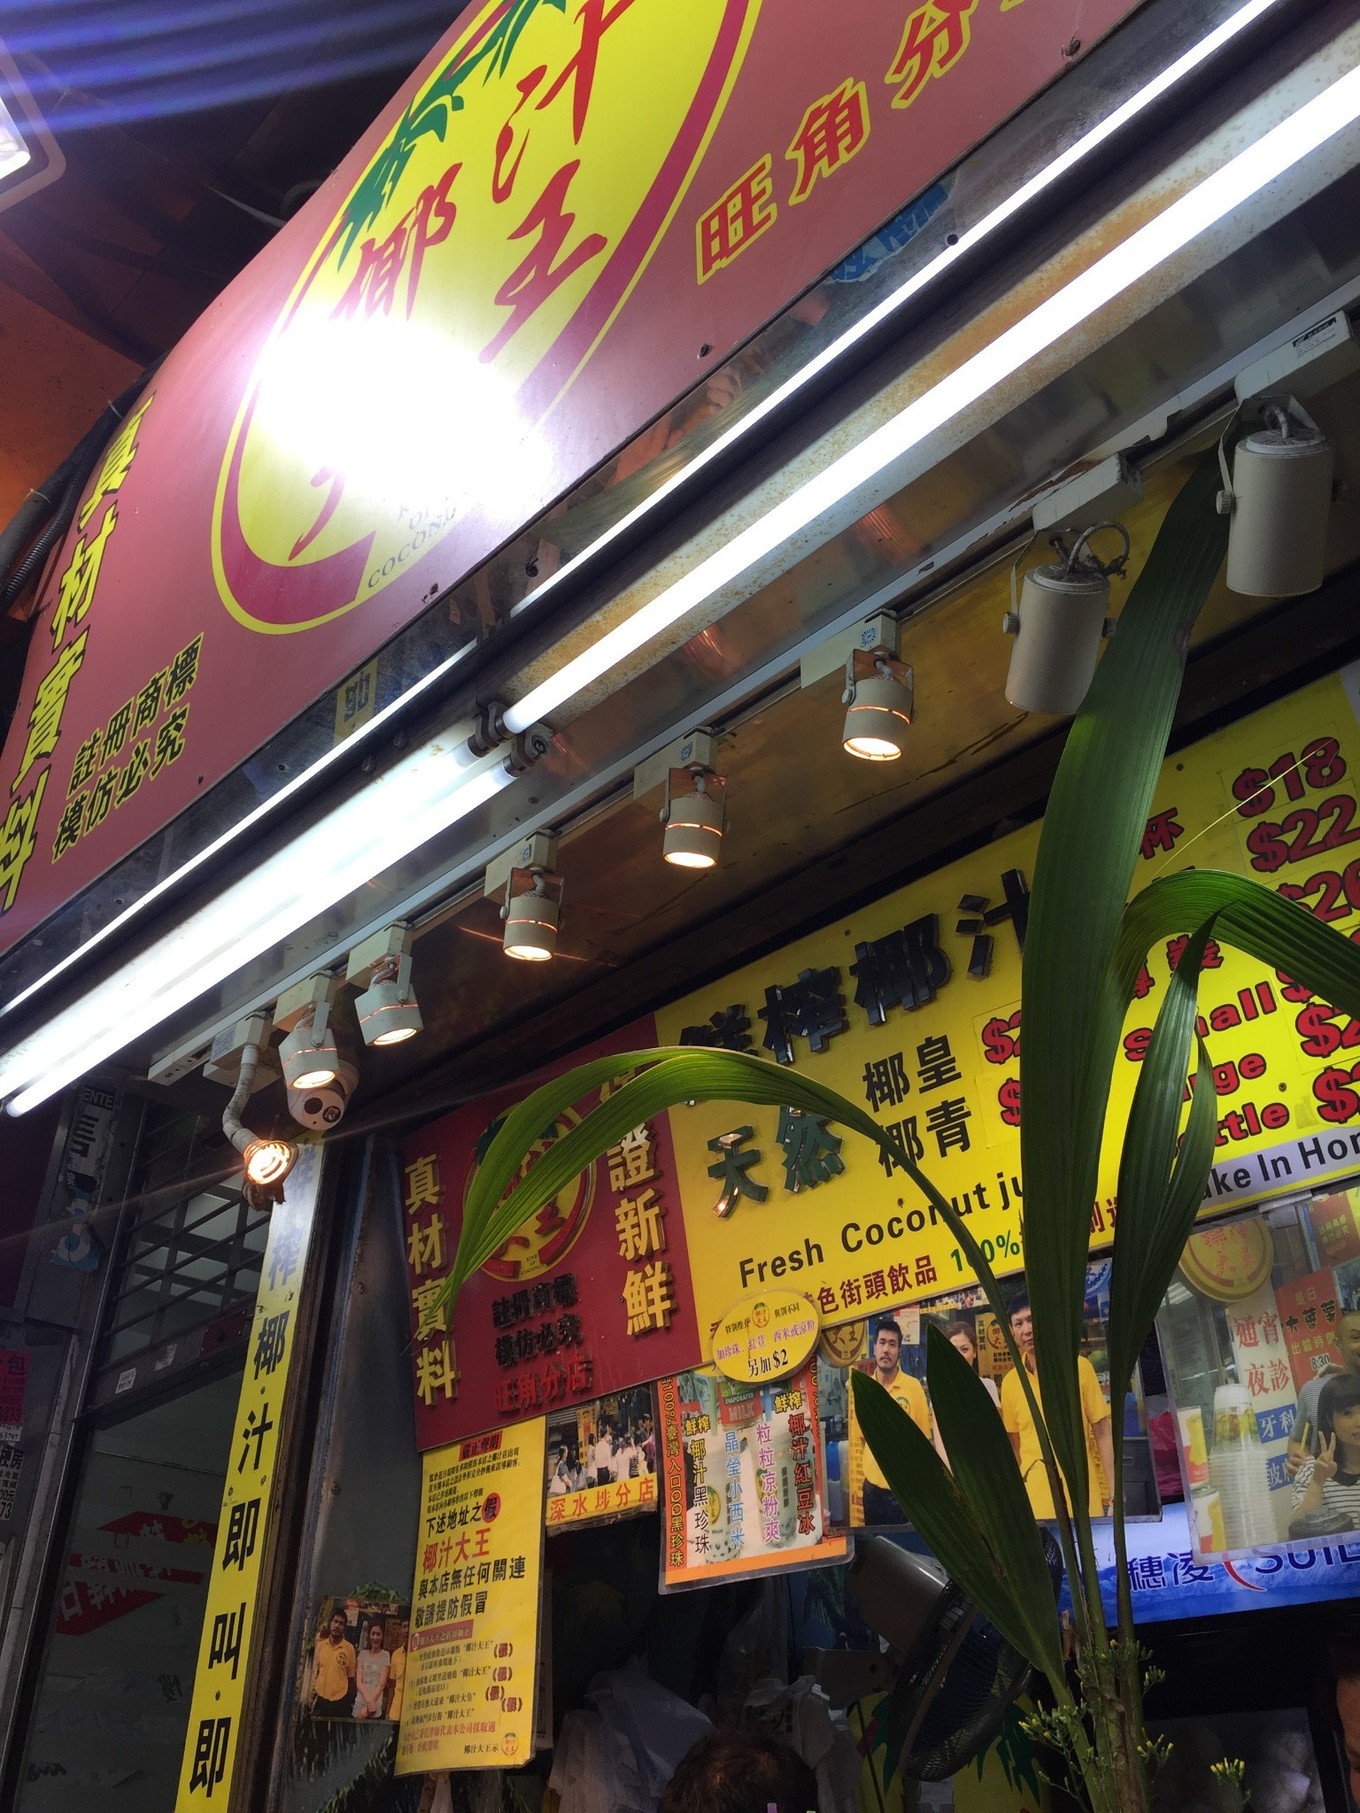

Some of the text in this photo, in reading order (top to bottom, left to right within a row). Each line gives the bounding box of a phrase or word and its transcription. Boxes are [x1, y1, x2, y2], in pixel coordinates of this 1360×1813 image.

[696, 0, 1024, 284] 旺角分
[0, 393, 154, 911] 真材實料
[67, 632, 203, 800] 註冊商標
[52, 702, 189, 865] 模仿必究
[1232, 736, 1347, 819] $18
[1246, 794, 1360, 873] $22
[1123, 980, 1277, 1061] Sall
[862, 1034, 962, 1113] 椰皇
[707, 1106, 846, 1218] 天然
[878, 1096, 972, 1178] 椰青
[1257, 1153, 1292, 1182] In
[599, 1066, 679, 1338] 證新鮮
[404, 1152, 459, 1406] 真材實料
[738, 1239, 825, 1288] Fresh
[803, 1254, 938, 1315] 色街頭飲品
[950, 1229, 1021, 1272] 10%
[1233, 1310, 1279, 1350] 通宵
[774, 1391, 802, 1414] 鮮榨
[1244, 1358, 1290, 1397] 夜診
[685, 1414, 711, 1437] 鮮榨
[549, 1477, 655, 1521] 深水埗分店
[690, 1438, 711, 1555] 椰汁黑珍珠
[724, 1429, 745, 1550] 晶瑩小西米
[788, 1413, 816, 1536] 椰汁紅豆冰
[417, 1555, 526, 1601] 與本店無任何關連
[422, 1527, 491, 1575] 椰汁大王
[414, 1590, 488, 1629] 敬請提防假冒
